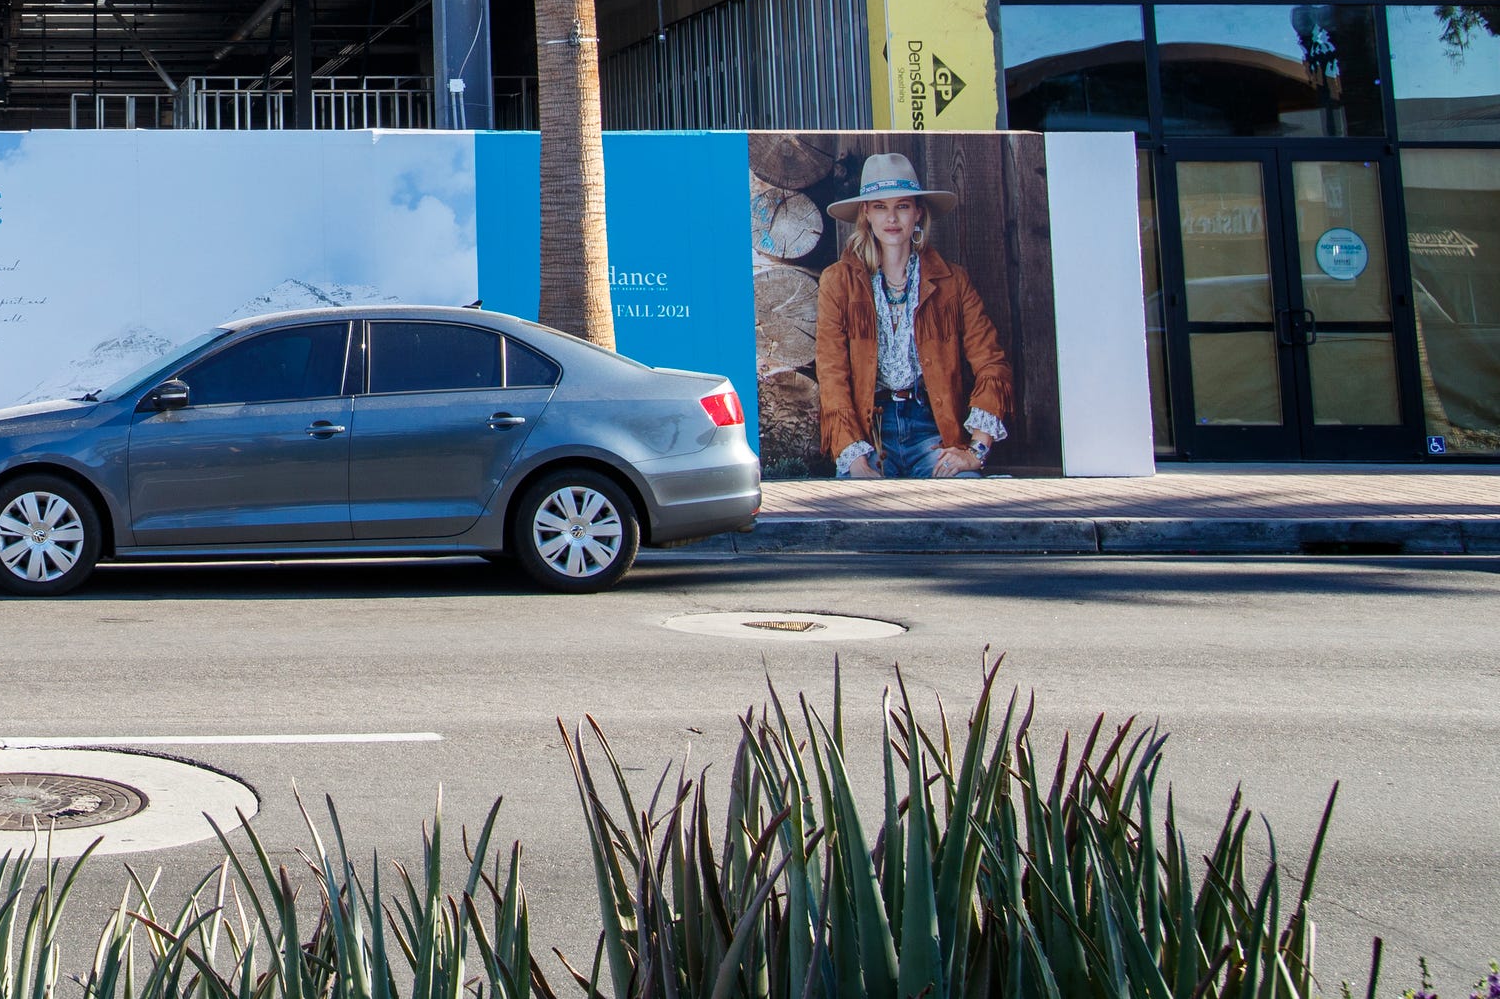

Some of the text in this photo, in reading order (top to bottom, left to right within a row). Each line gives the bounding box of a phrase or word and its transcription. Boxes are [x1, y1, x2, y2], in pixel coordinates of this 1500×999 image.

[908, 41, 926, 130] DensGlass
[935, 67, 952, 101] GP
[609, 265, 668, 286] dance
[617, 304, 690, 317] FALL 2021
